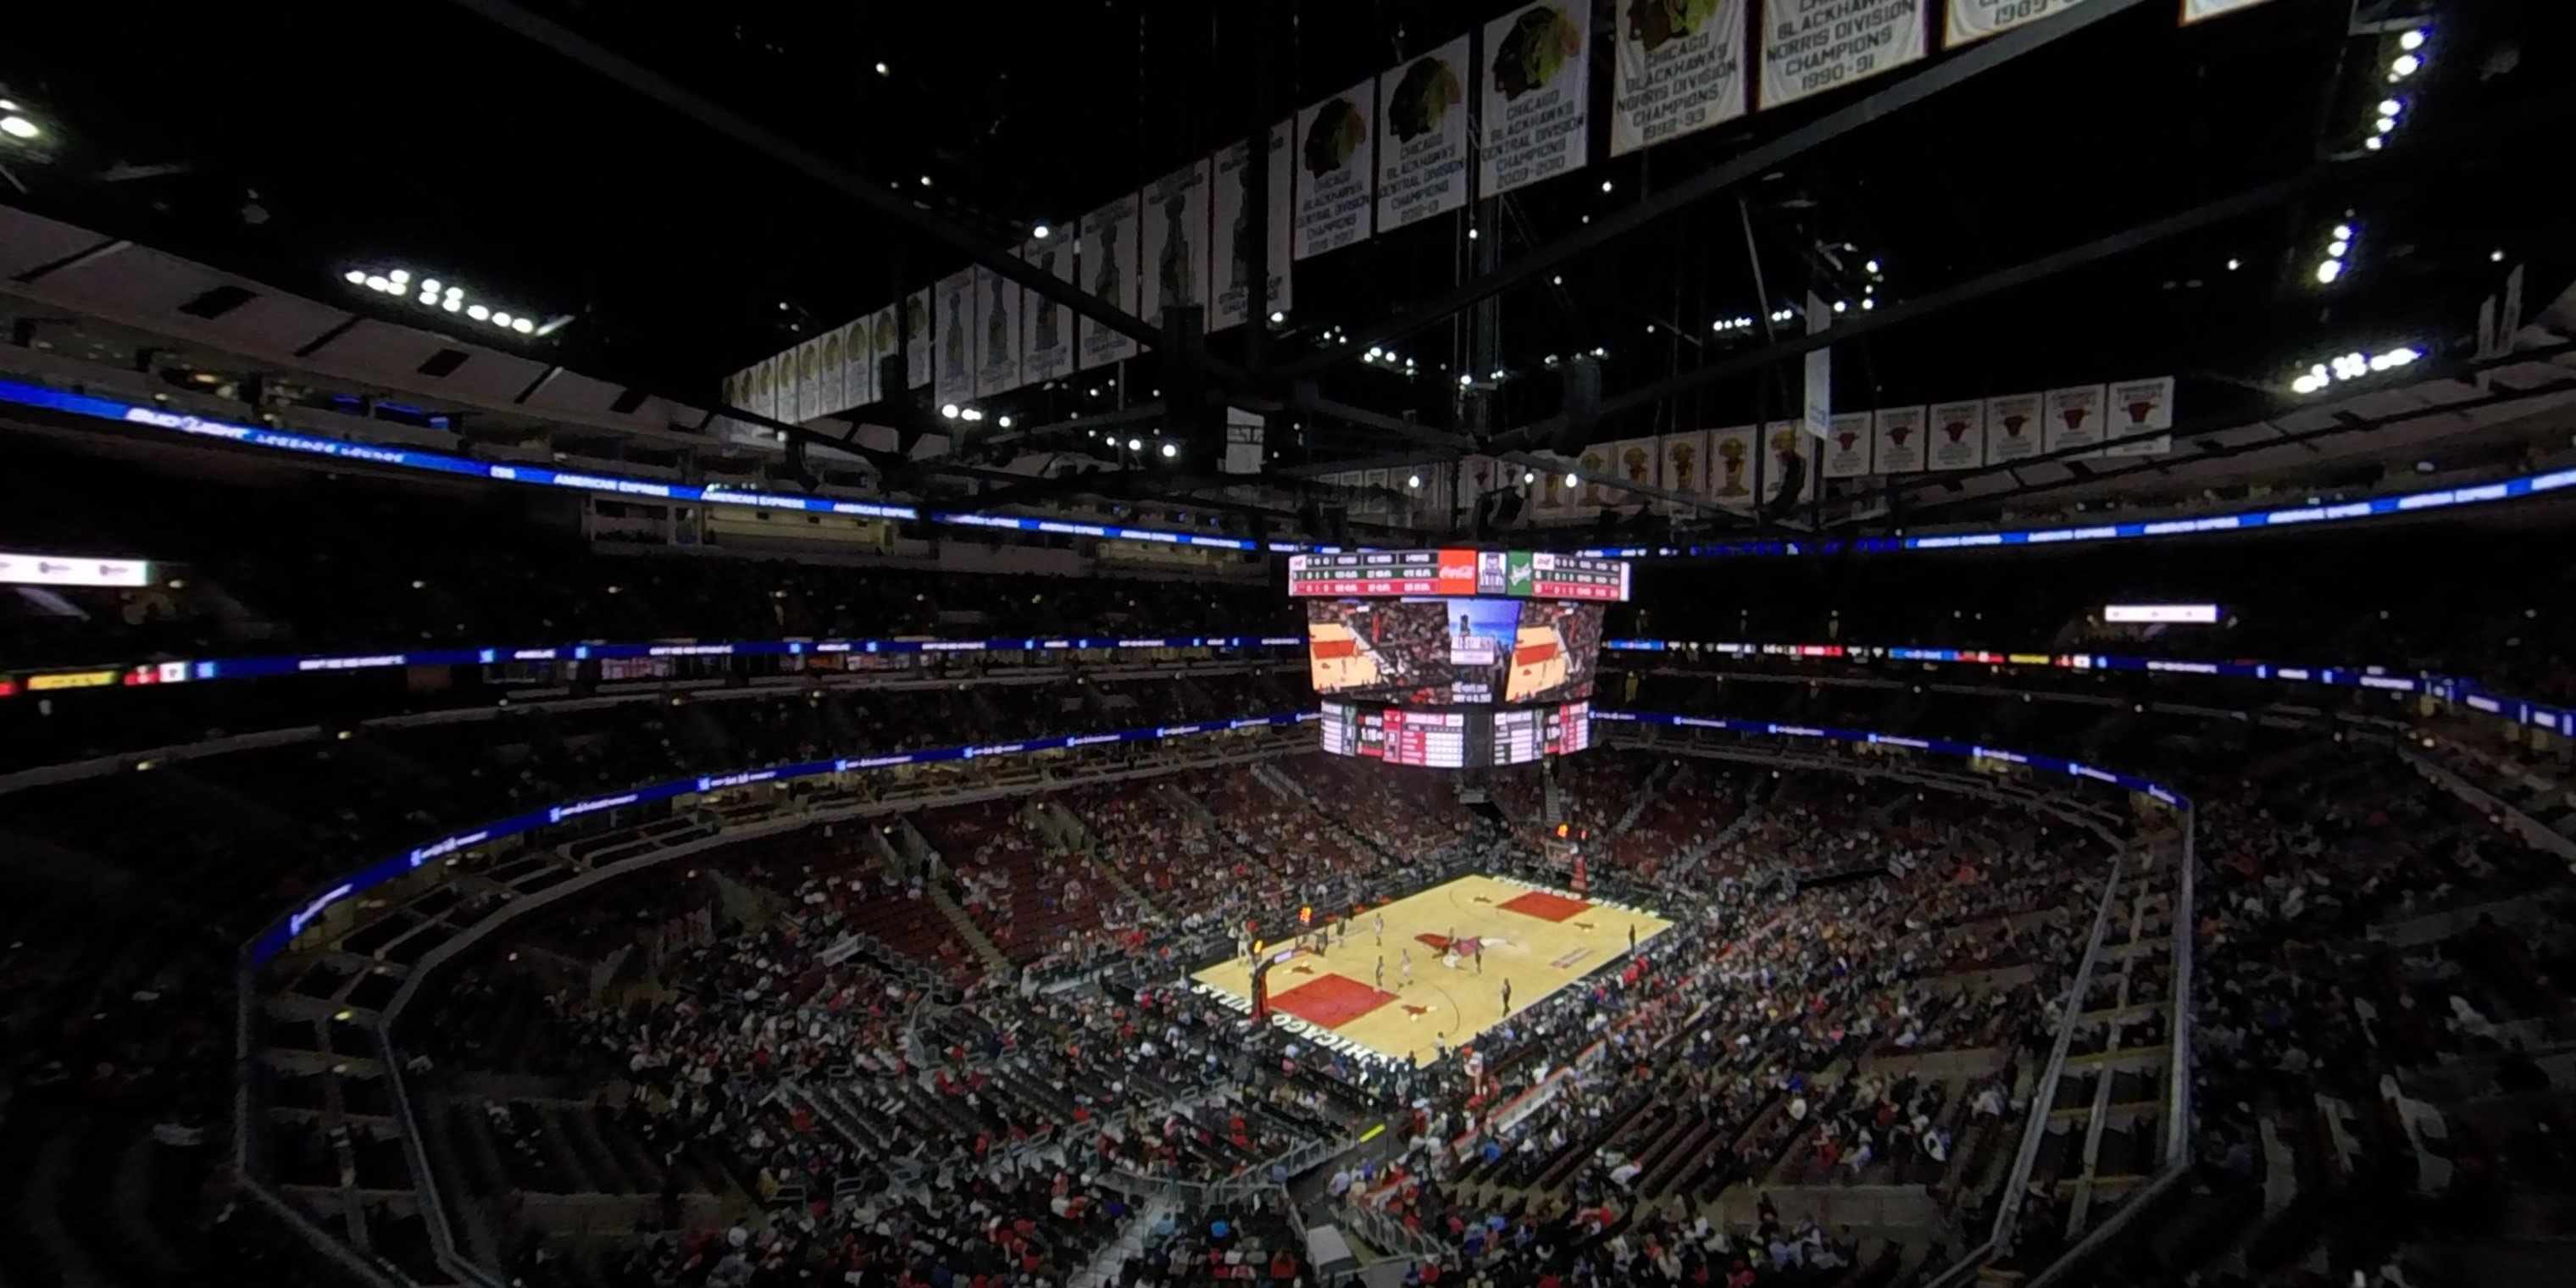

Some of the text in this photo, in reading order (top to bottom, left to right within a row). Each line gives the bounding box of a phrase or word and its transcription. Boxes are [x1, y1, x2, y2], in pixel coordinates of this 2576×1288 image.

[1645, 32, 1708, 69] CHICAGO
[1767, 0, 1916, 63] NORRIS DIVISION
[1785, 25, 1892, 76] CHAMPIONS
[1618, 58, 1736, 113] NORRIS DIVISION
[1625, 42, 1728, 95] BLACKHAWKS
[1802, 53, 1874, 92] 1990-91
[1491, 99, 1574, 143] BLACKHAWKS
[1507, 89, 1560, 120] CHICAGO
[1633, 84, 1718, 127] CHAMPIONS
[1400, 133, 1444, 160] CHICAGO
[1482, 114, 1585, 162] CENTRAL DIVISION
[1496, 137, 1566, 173] CHAMPIONS
[1386, 144, 1456, 180] BLACKHAWKS
[1391, 179, 1449, 211] CHAMPIONS
[553, 474, 669, 497] AMERICAN EXPRESS
[701, 489, 805, 509] AMERICAN EXPRESS
